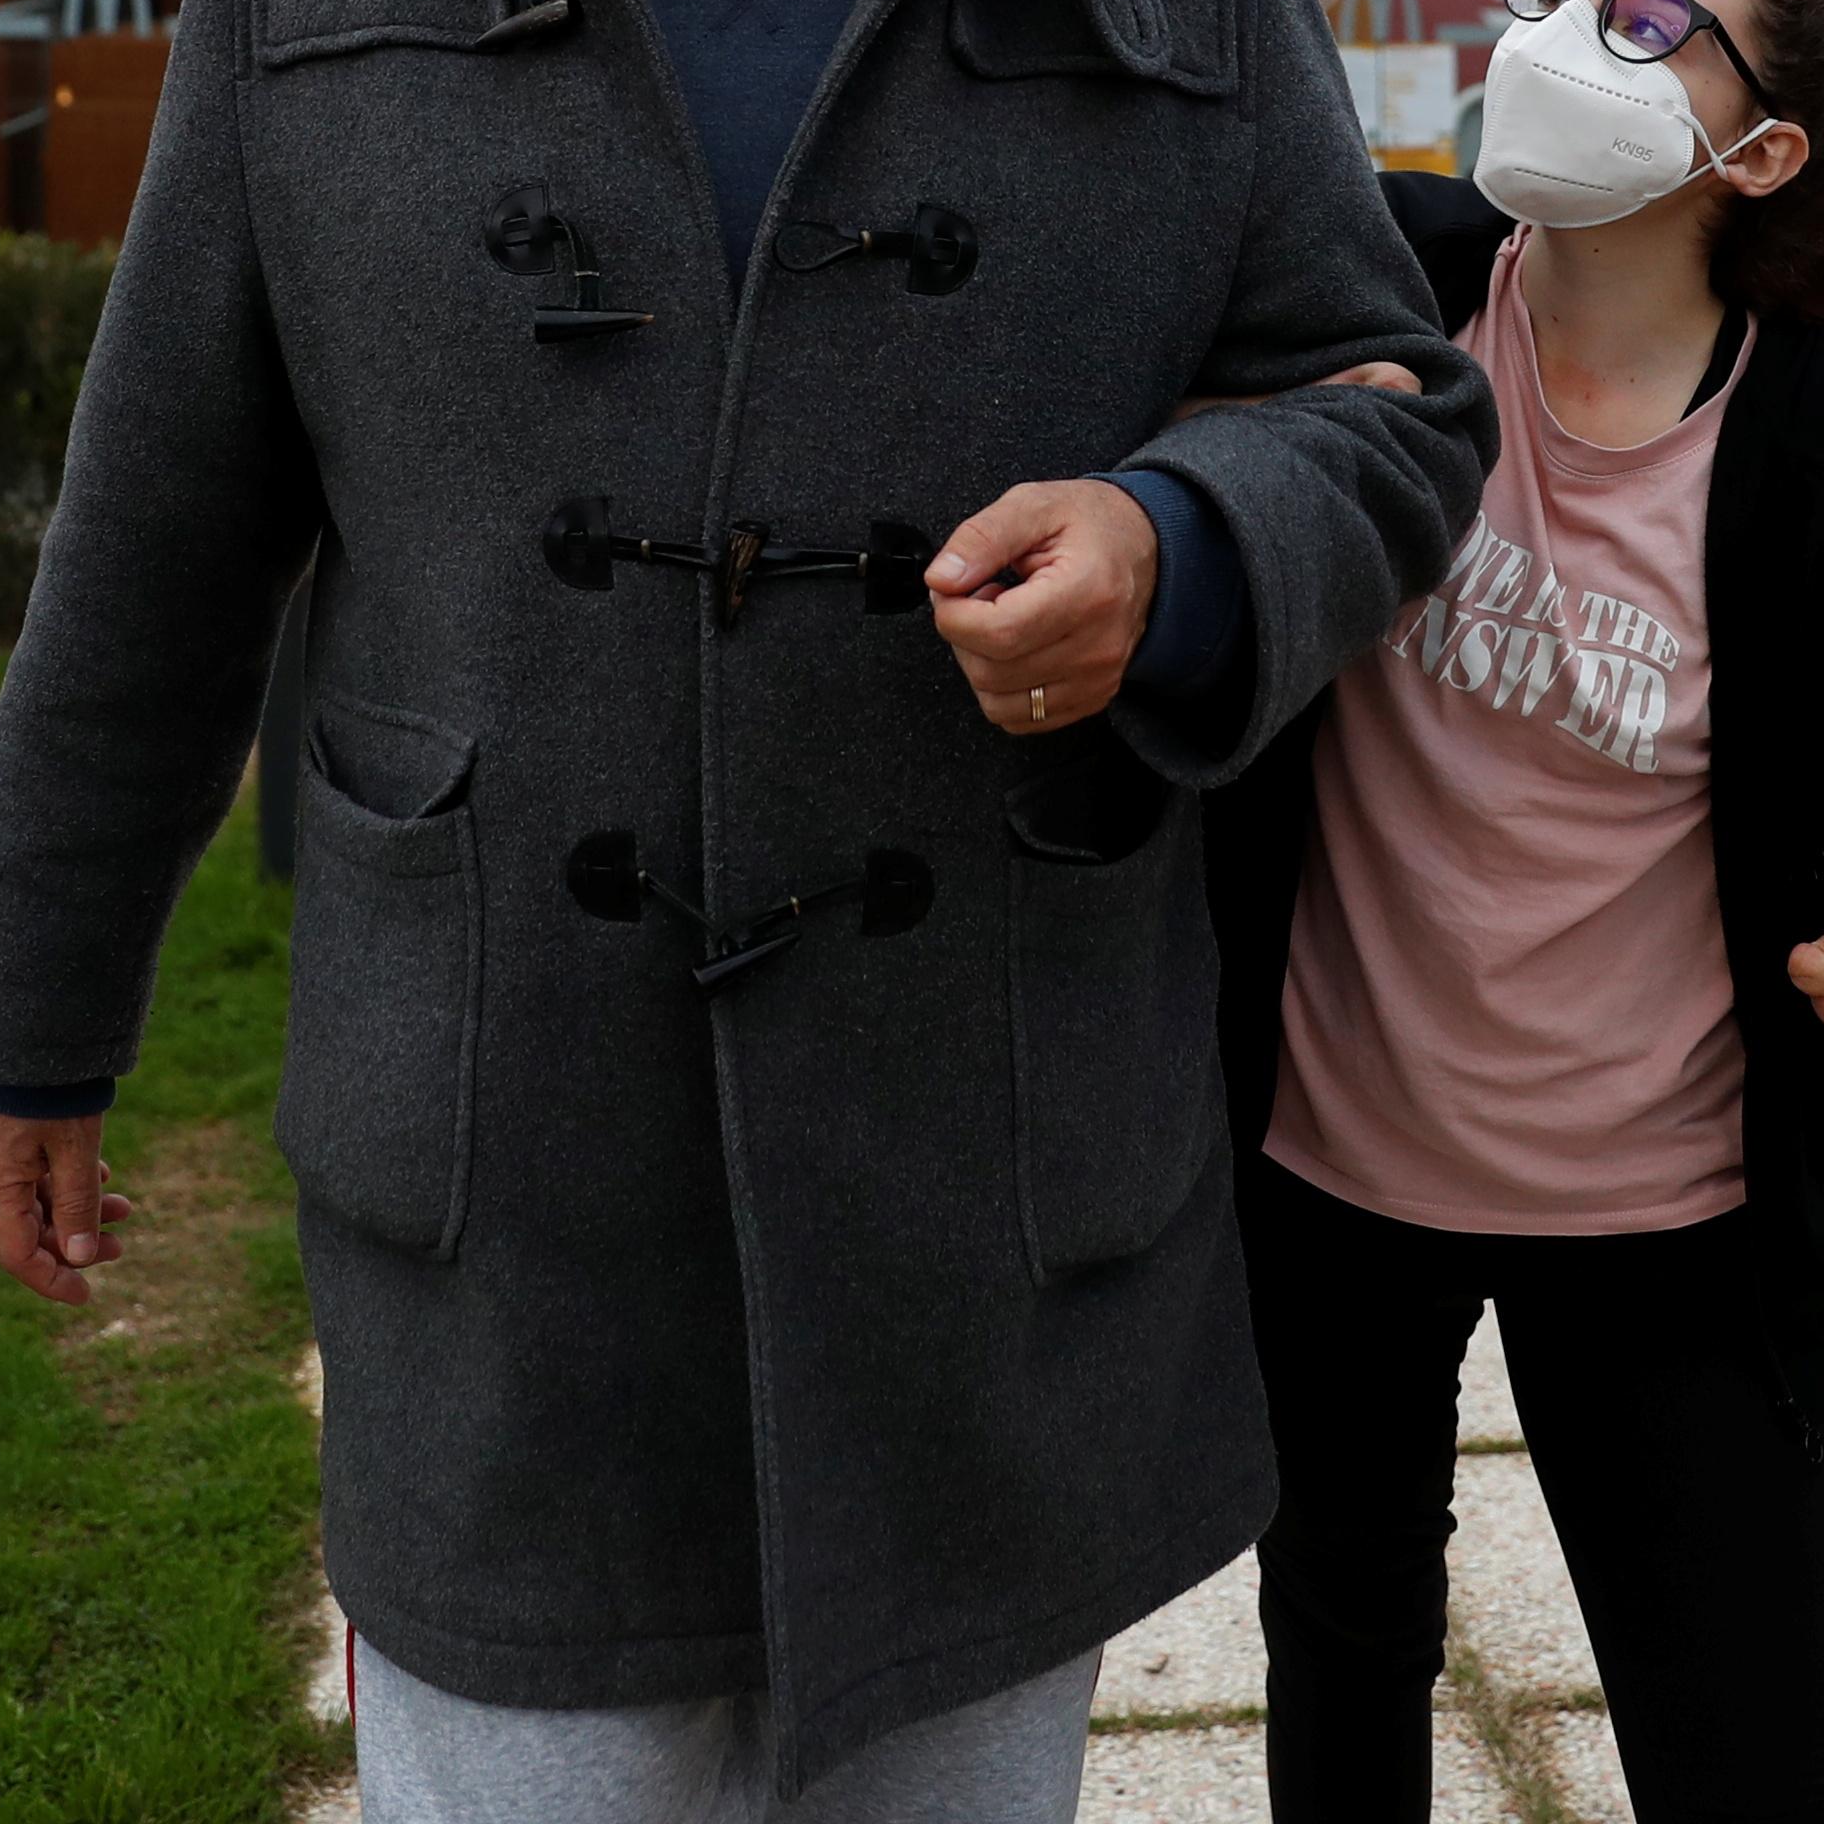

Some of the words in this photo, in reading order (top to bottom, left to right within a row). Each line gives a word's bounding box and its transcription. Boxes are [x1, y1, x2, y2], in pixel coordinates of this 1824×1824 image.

[1611, 136, 1655, 162] KN95
[1443, 509, 1534, 615] VE
[1578, 590, 1680, 672] THE
[1382, 594, 1668, 774] NSWER
